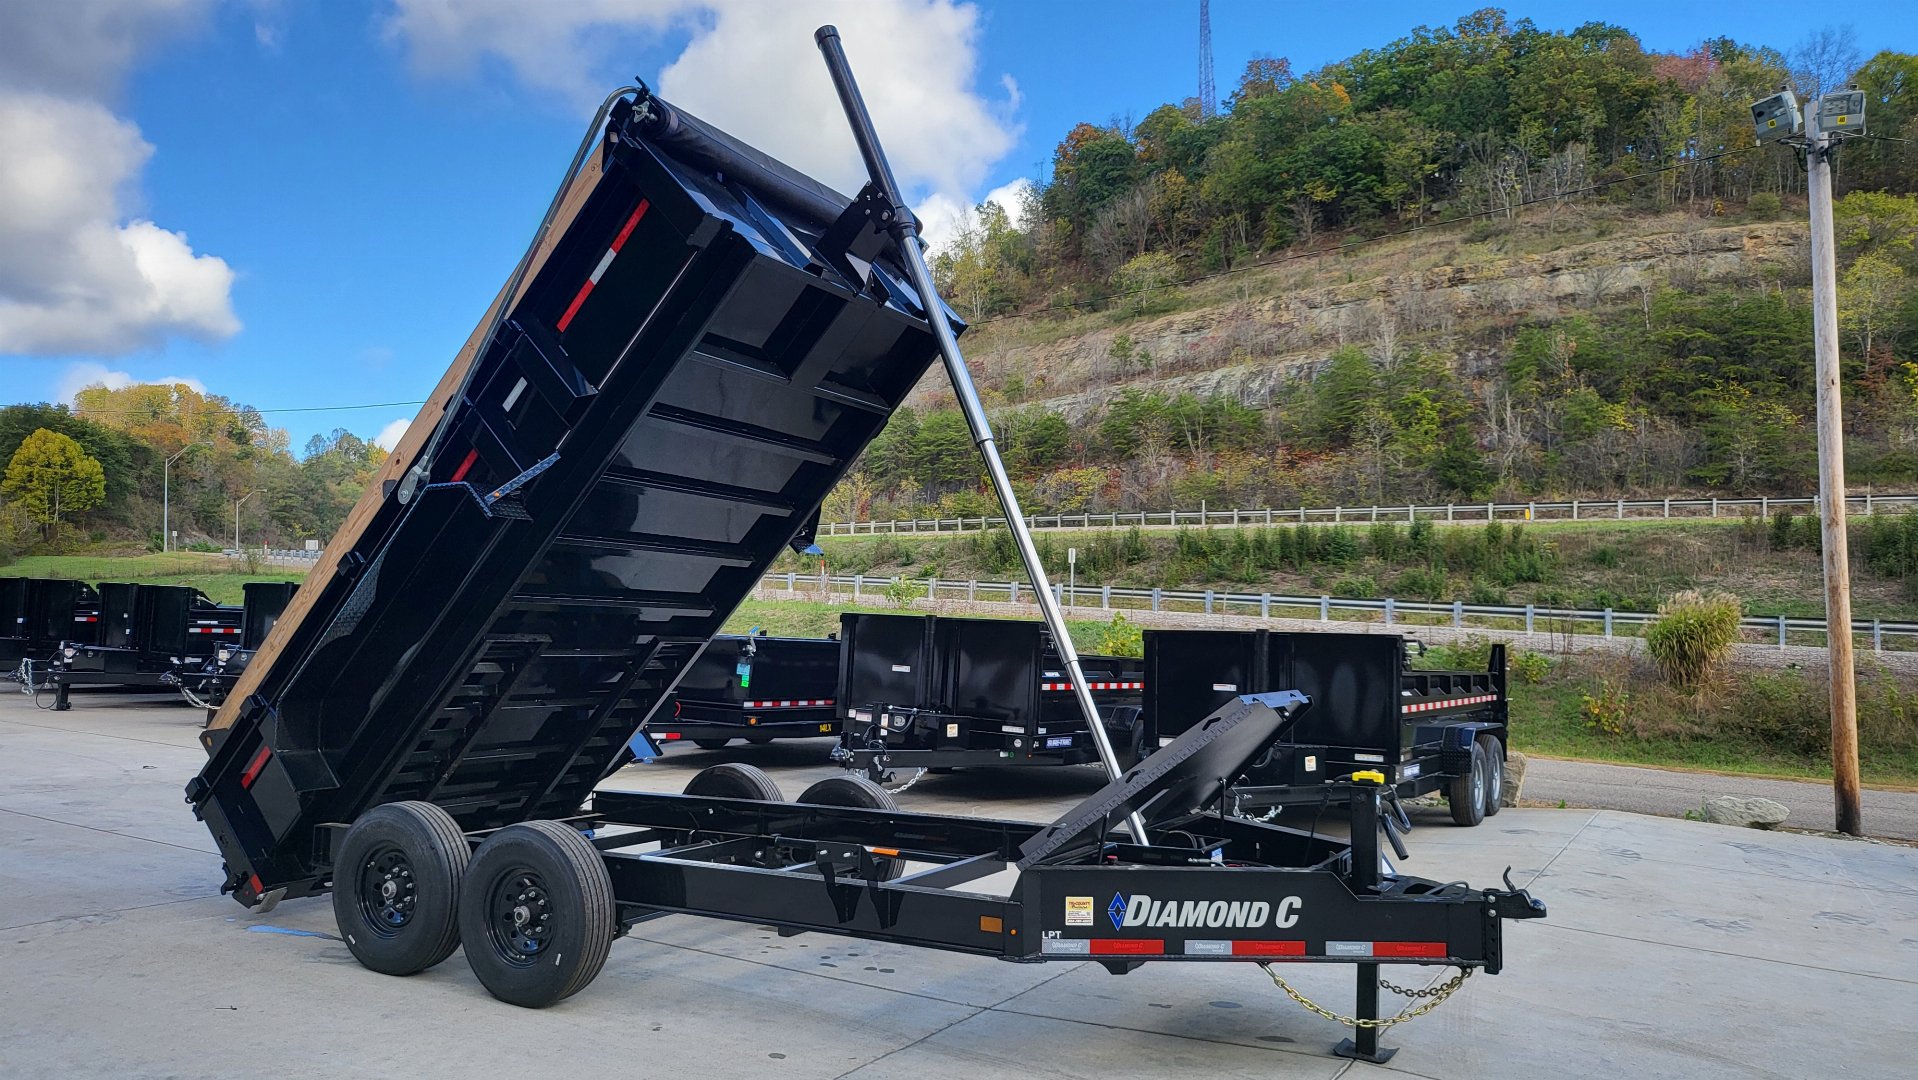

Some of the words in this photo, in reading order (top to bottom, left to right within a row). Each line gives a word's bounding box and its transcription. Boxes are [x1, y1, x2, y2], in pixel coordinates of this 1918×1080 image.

[1122, 894, 1270, 928] DIAMOND
[1275, 896, 1302, 929] C
[1042, 931, 1062, 939] LPT
